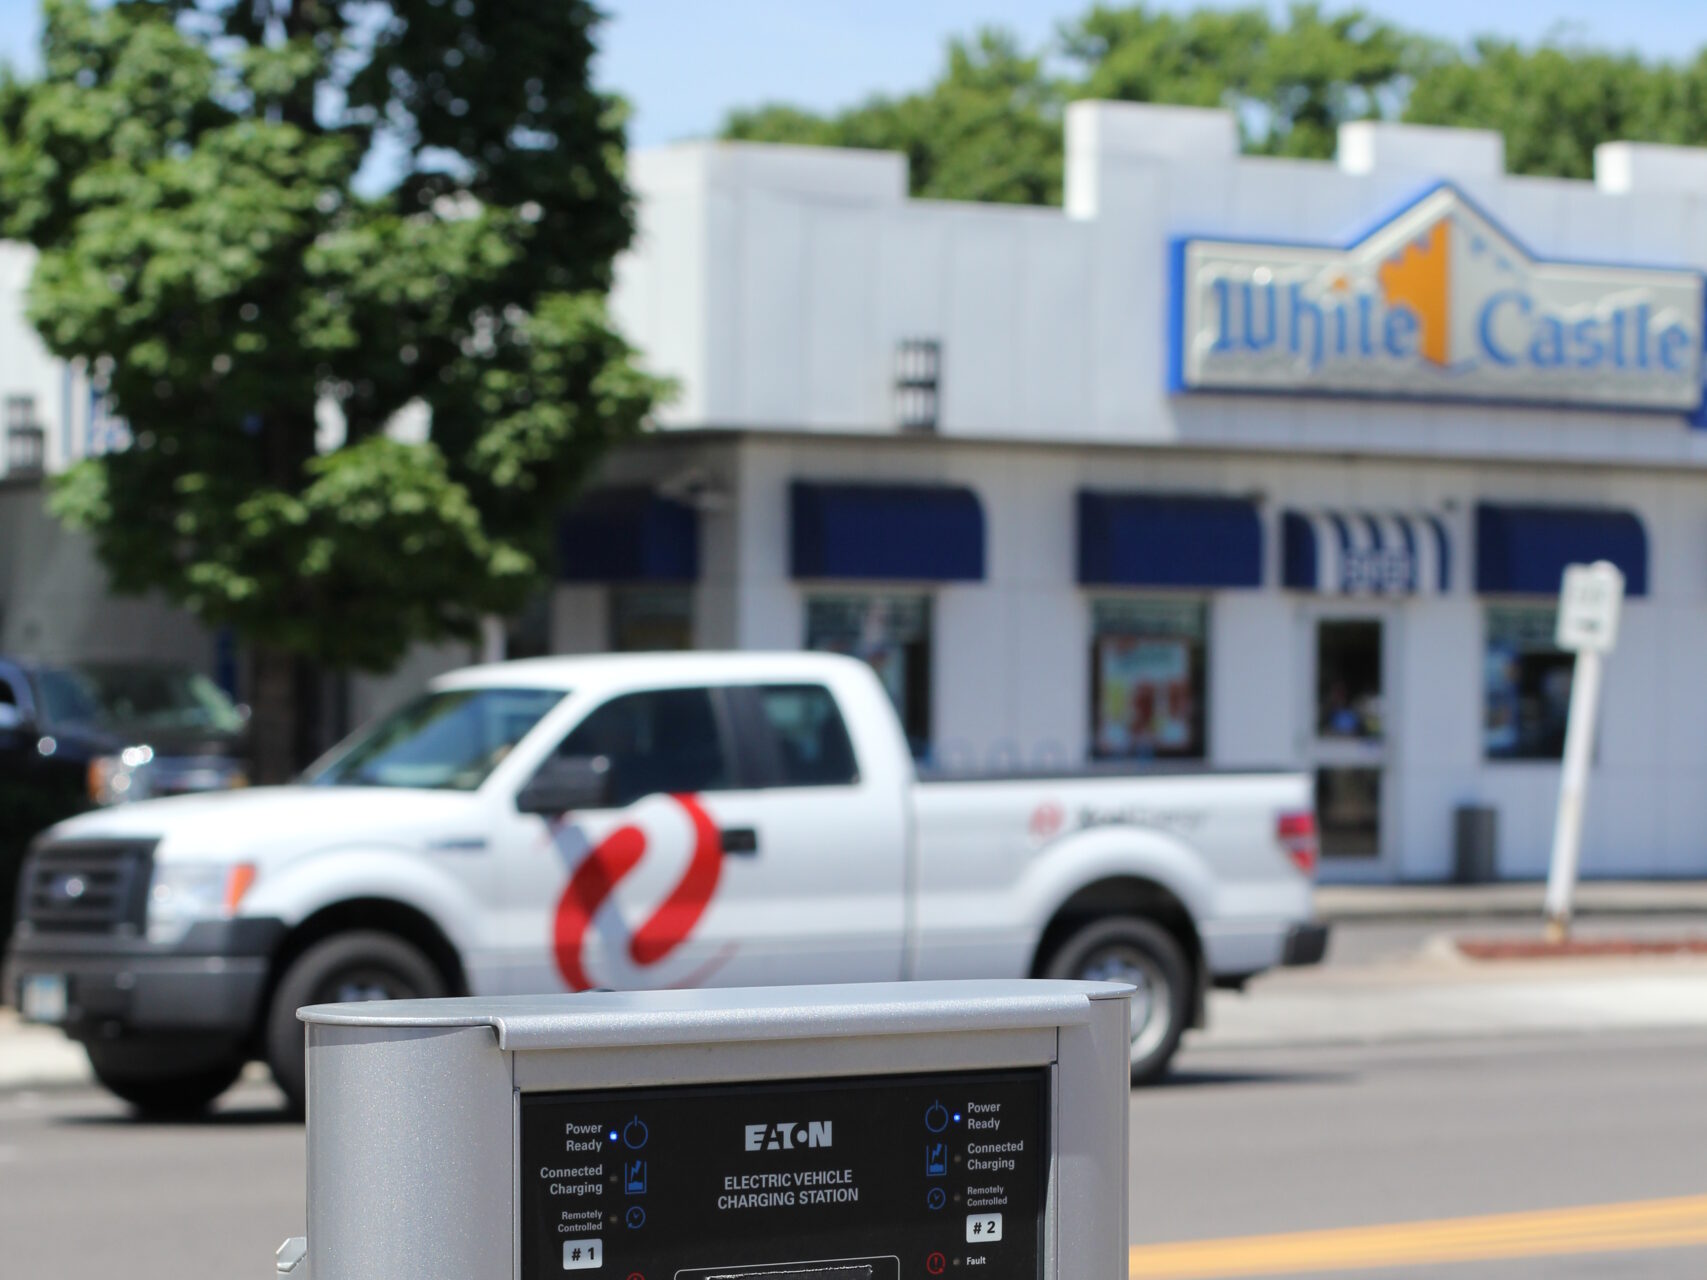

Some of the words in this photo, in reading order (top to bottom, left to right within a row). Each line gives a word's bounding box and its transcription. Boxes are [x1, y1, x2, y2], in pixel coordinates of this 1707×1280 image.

[1211, 276, 1421, 373] White
[1479, 288, 1691, 371] Castle
[968, 1102, 1001, 1114] Power
[566, 1123, 603, 1135] Power
[968, 1118, 1000, 1131] Ready
[745, 1120, 833, 1151] EATON
[566, 1140, 603, 1153] Ready
[967, 1140, 1024, 1154] Connected
[967, 1157, 1015, 1171] Charging
[540, 1164, 603, 1179] Connected
[724, 1173, 791, 1190] ELECTRIC
[793, 1169, 853, 1186] VEHICLE
[550, 1183, 603, 1196] Charging
[967, 1185, 1005, 1196] Remotely
[717, 1191, 795, 1210] CHARGING
[799, 1188, 859, 1204] STATION
[967, 1197, 1008, 1207] Controlled
[561, 1210, 603, 1221] Remotely
[557, 1222, 603, 1233] Controlled
[966, 1257, 986, 1266] Fault
